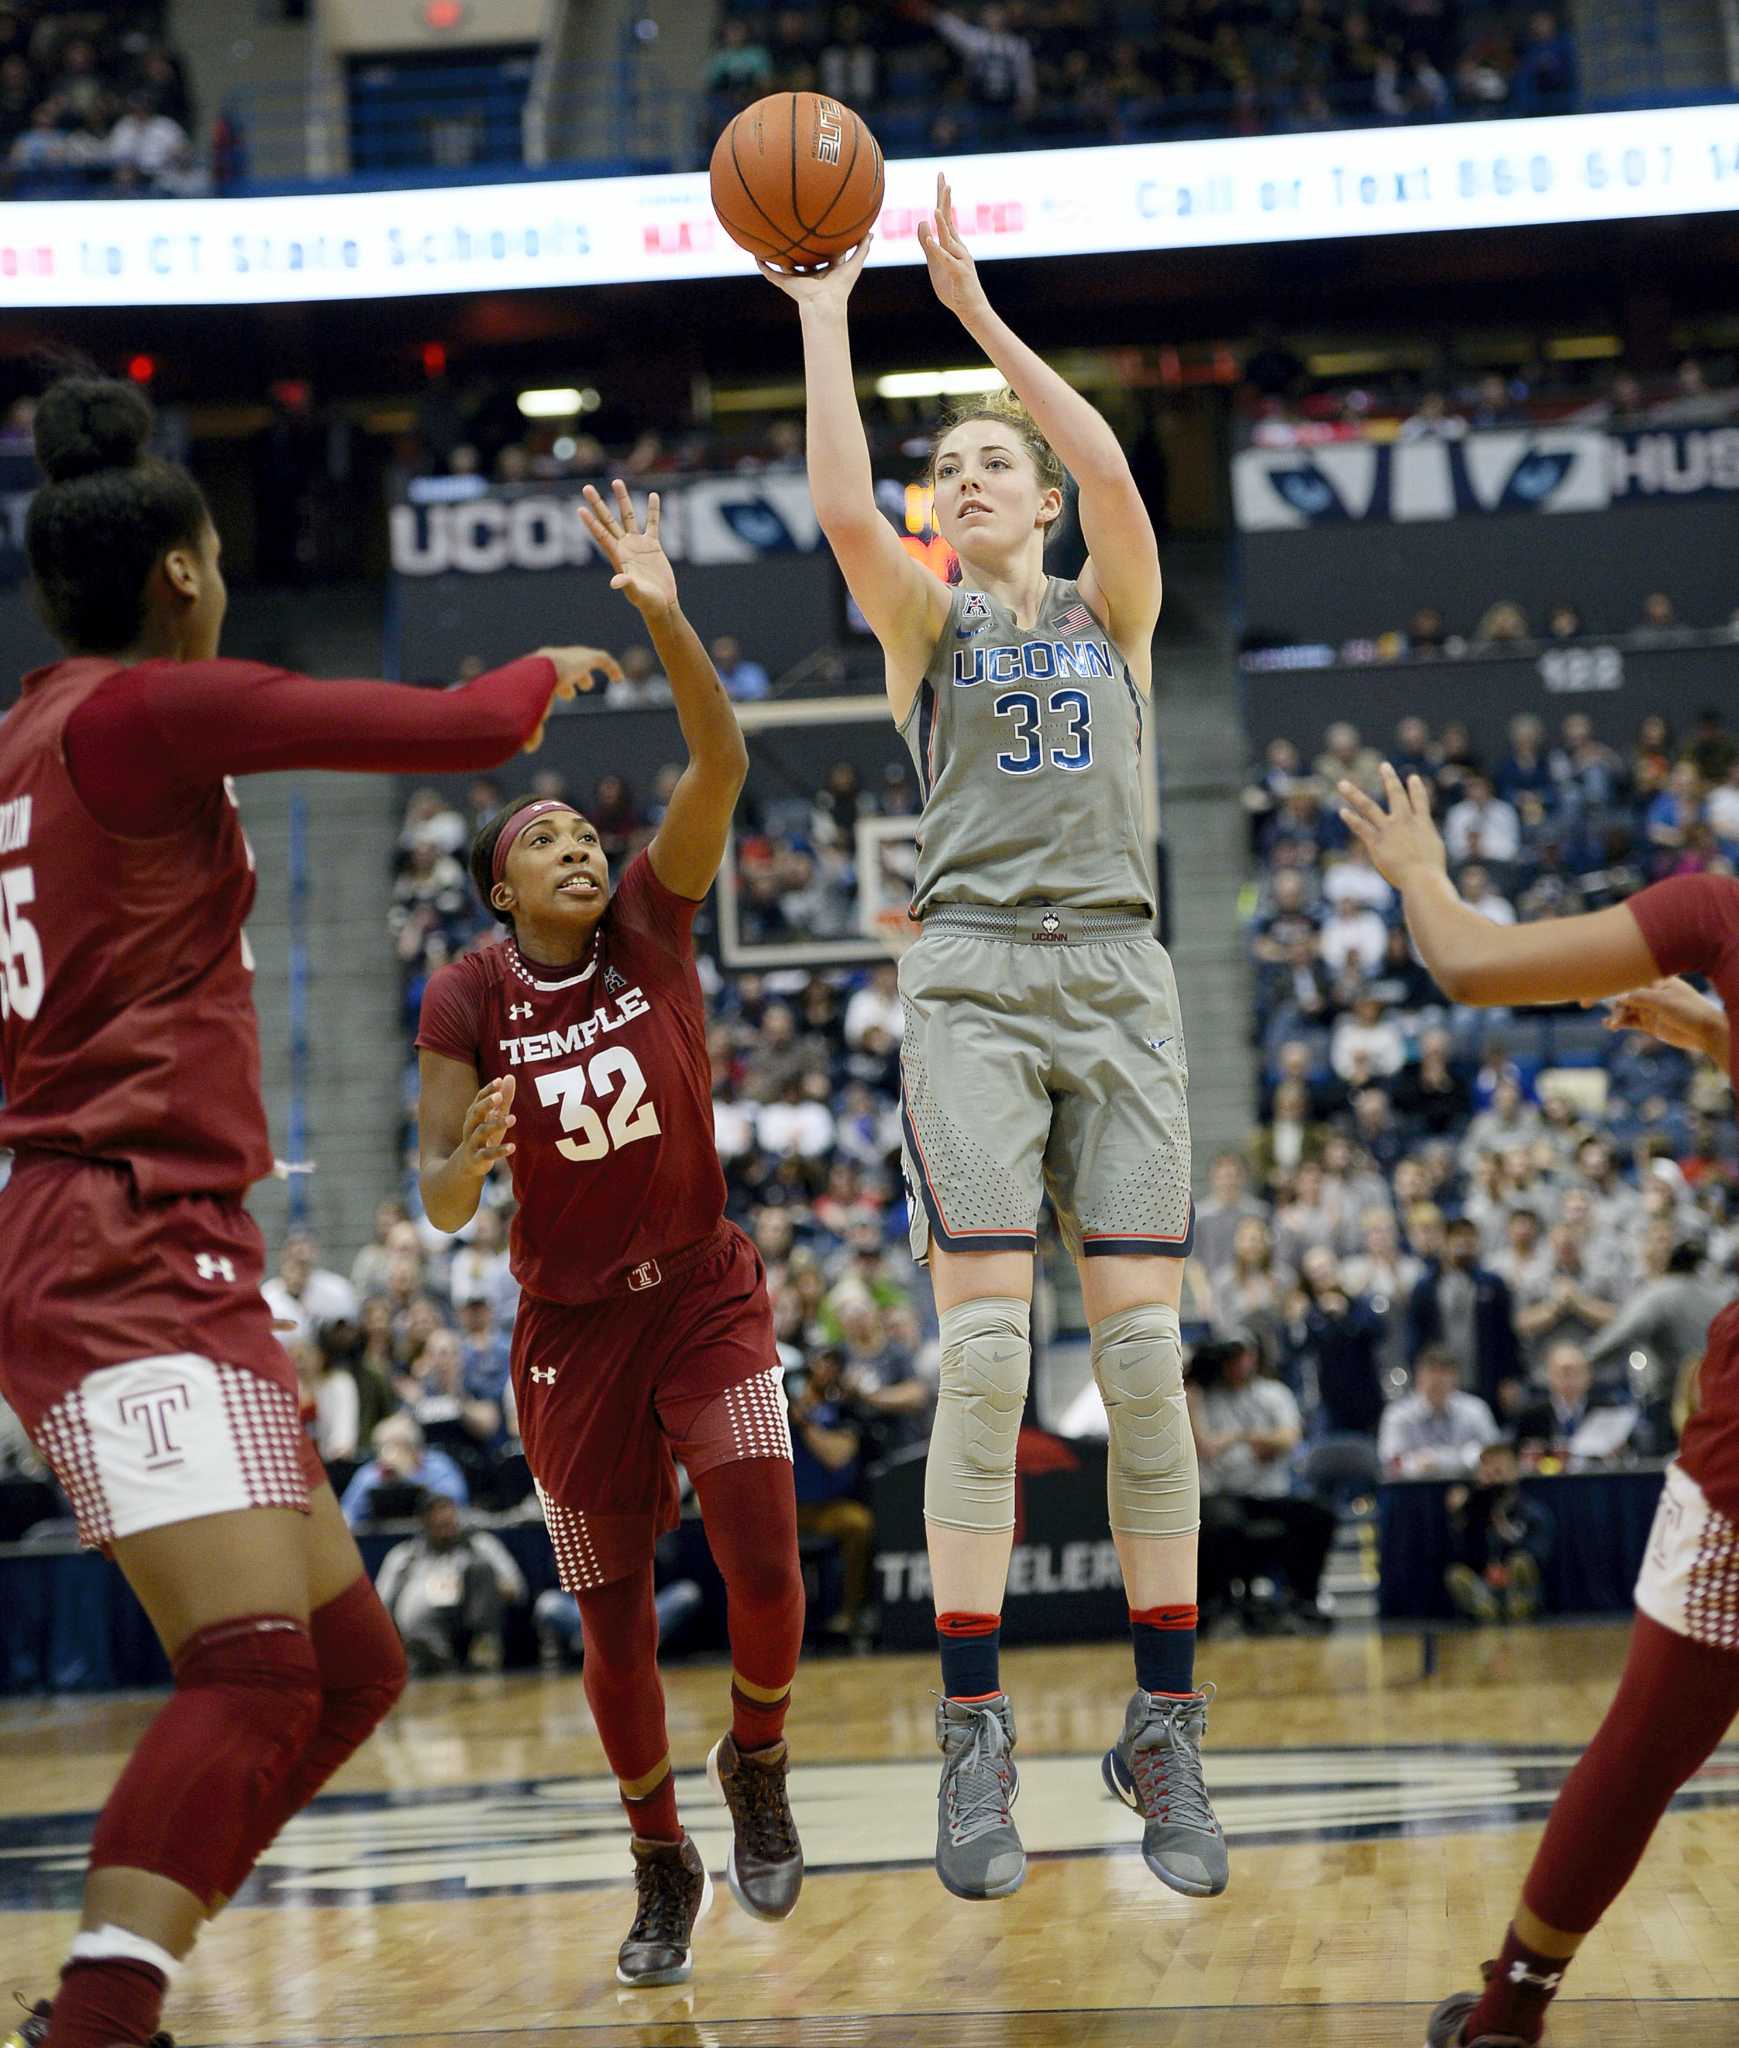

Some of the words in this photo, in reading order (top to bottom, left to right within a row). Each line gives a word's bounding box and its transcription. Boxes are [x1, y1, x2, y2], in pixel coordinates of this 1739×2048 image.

[1136, 173, 1235, 220] Call
[1259, 178, 1303, 214] or
[1330, 162, 1432, 208] Text
[1583, 144, 1674, 192] 607
[80, 238, 124, 276] to
[148, 233, 203, 277] CT
[228, 232, 358, 275] State
[387, 218, 591, 267] Schools
[953, 640, 1115, 688] UCONN
[994, 688, 1093, 775] 33
[0, 866, 45, 1021] 5
[1031, 932, 1068, 942] UCONN
[500, 986, 650, 1065] TEMPLE
[534, 1045, 662, 1161] 32
[118, 1383, 190, 1472] T
